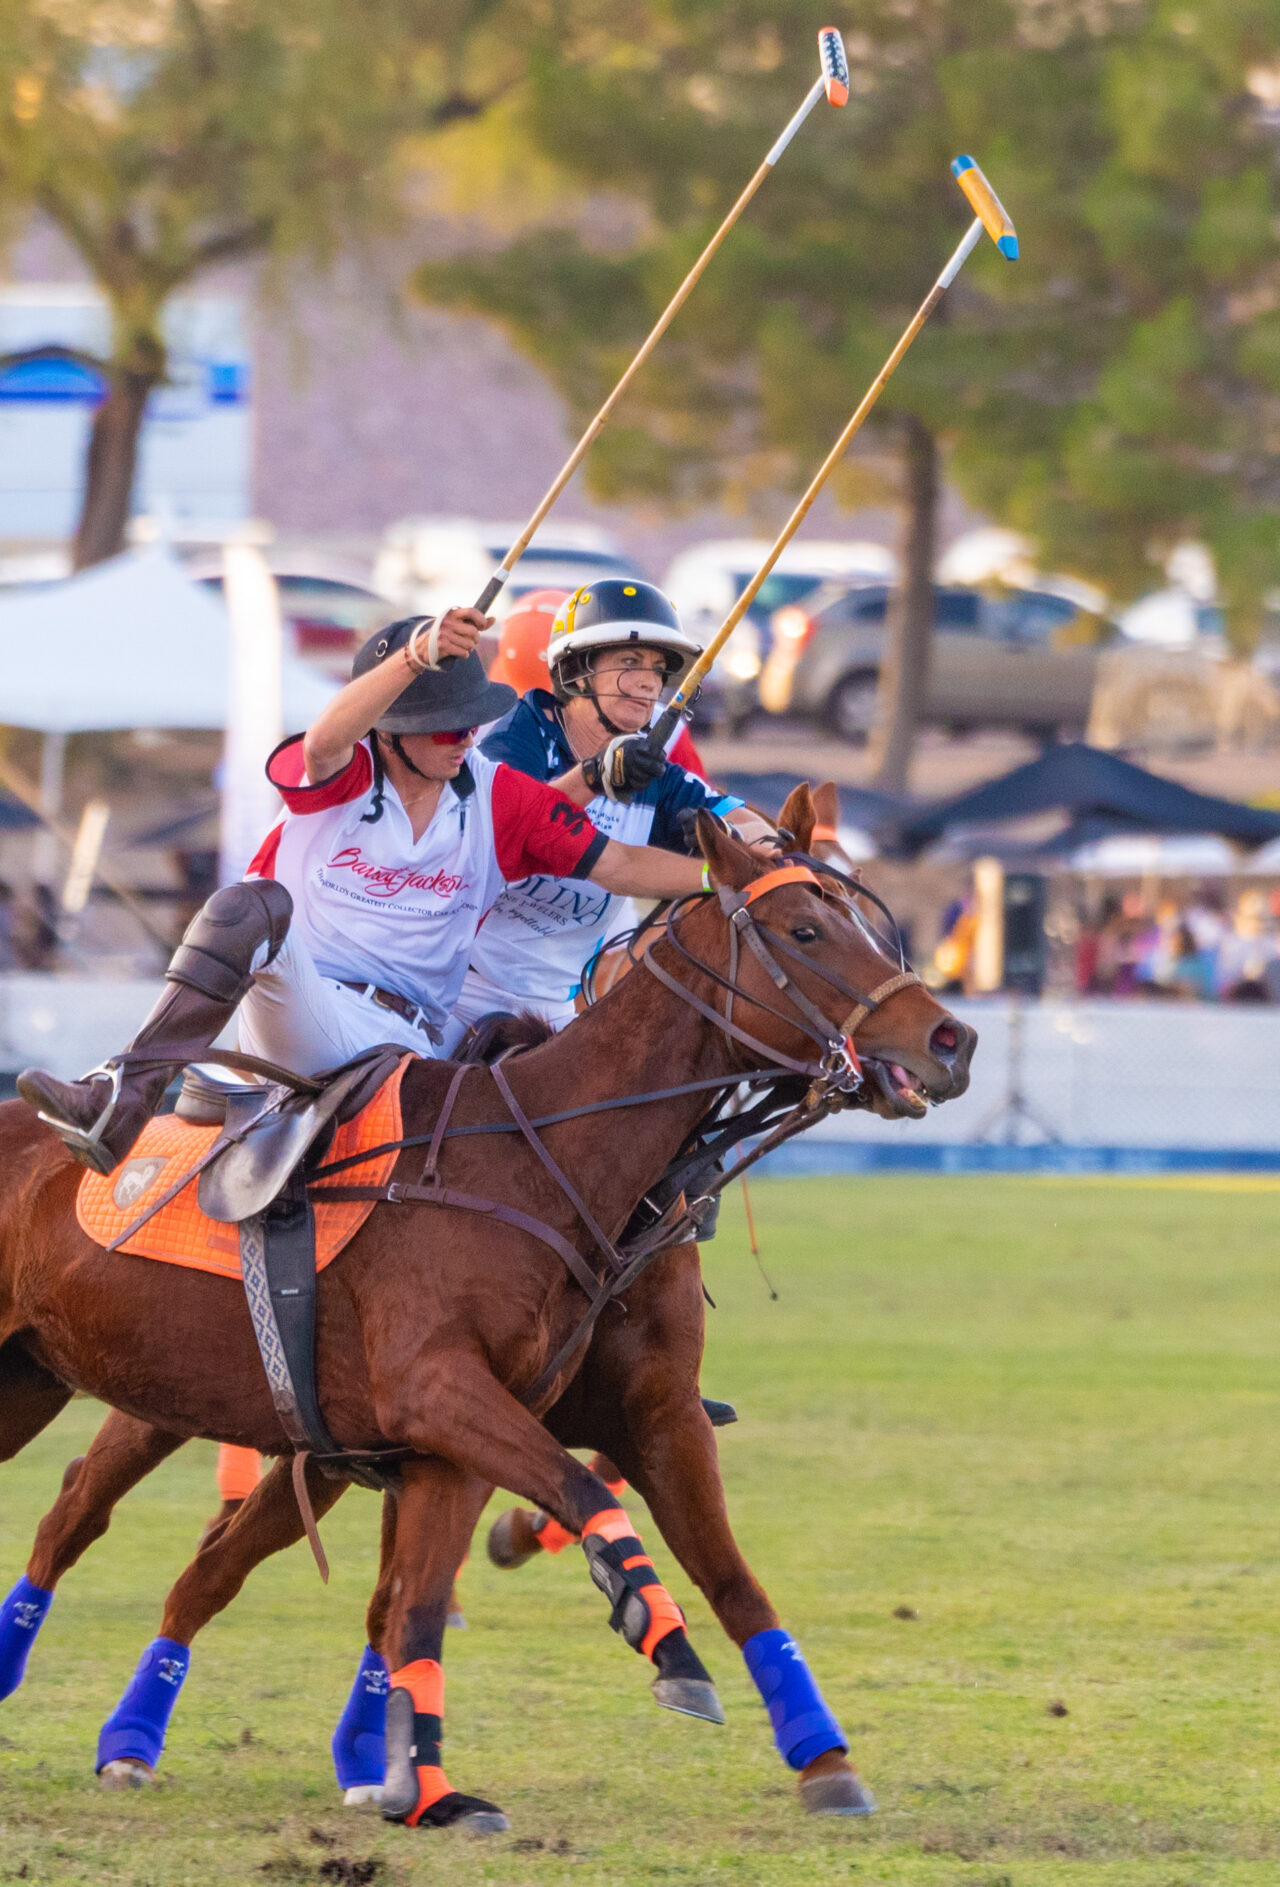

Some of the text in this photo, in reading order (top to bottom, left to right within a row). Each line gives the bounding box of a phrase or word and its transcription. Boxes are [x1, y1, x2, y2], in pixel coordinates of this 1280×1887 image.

[550, 801, 588, 836] 3
[350, 891, 387, 909] GREATEST
[388, 903, 433, 917] COLLECTOR
[504, 876, 612, 927] OLINA
